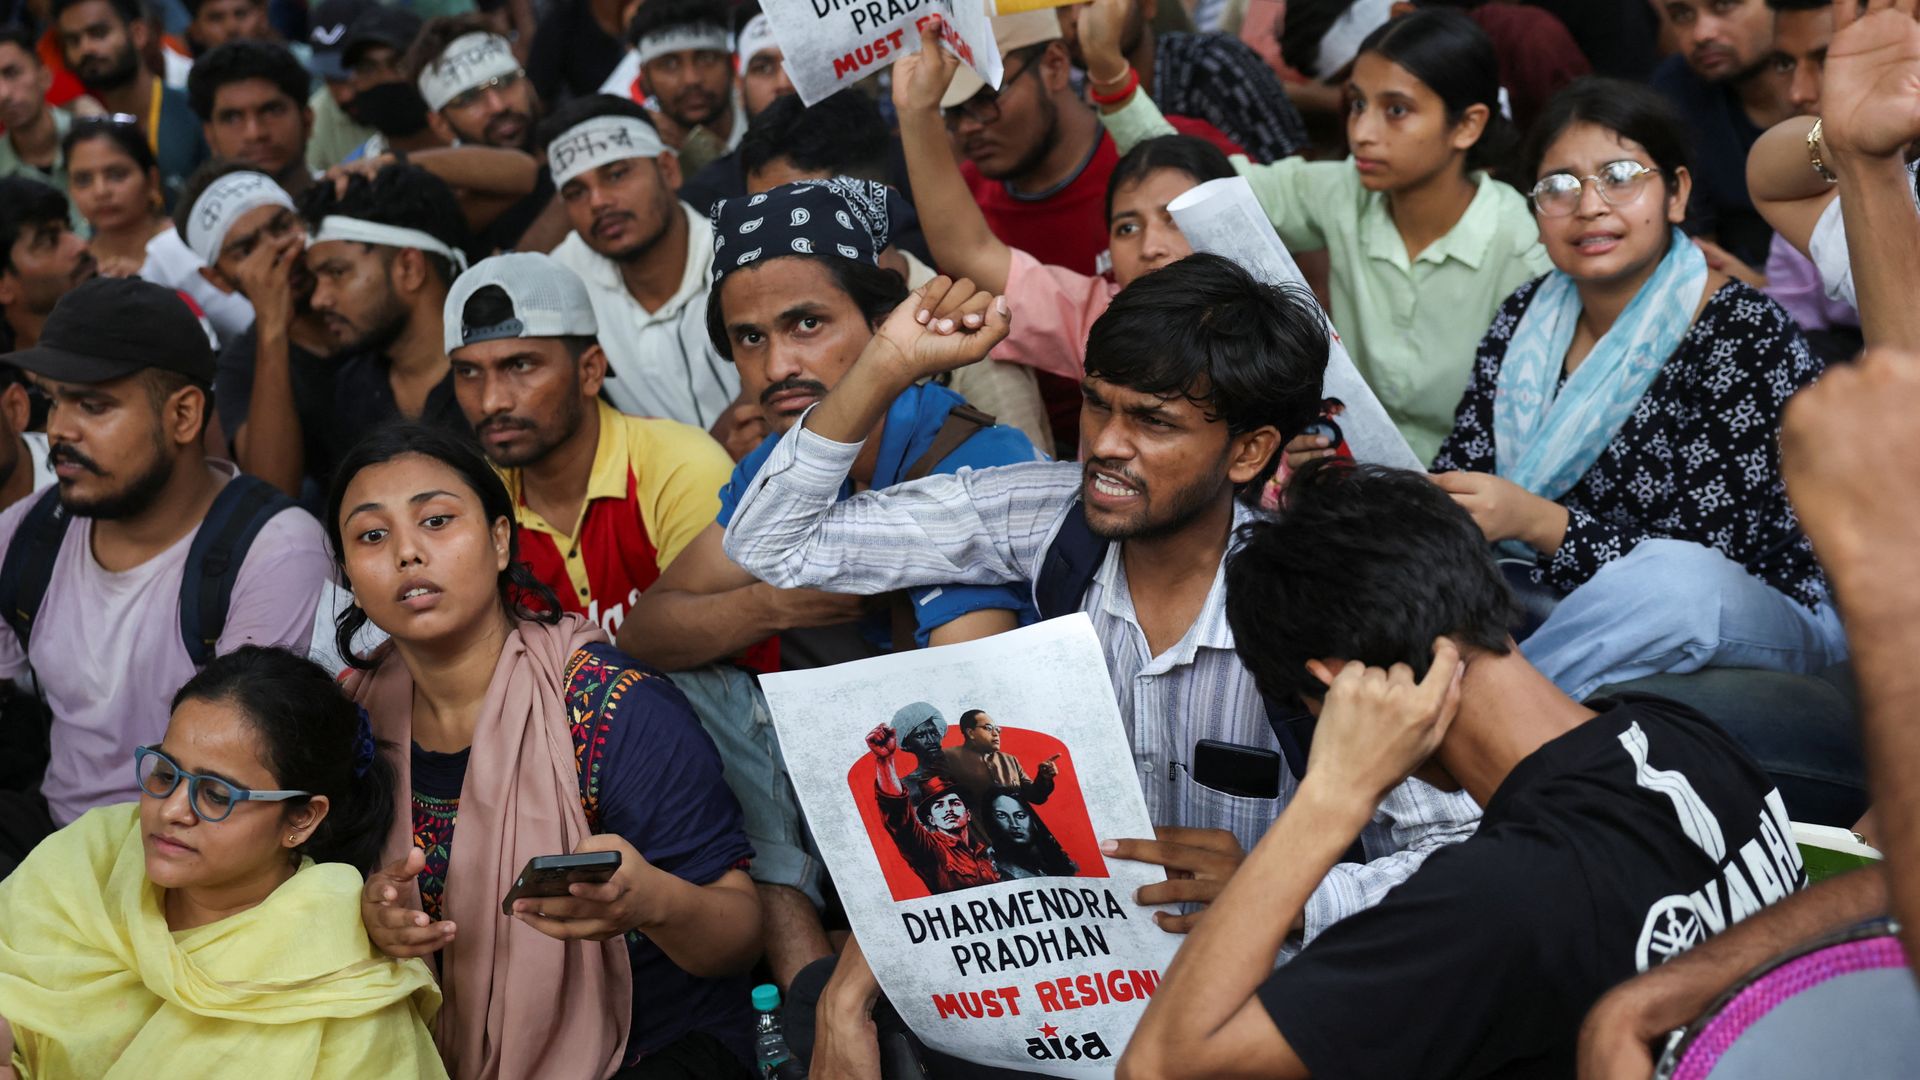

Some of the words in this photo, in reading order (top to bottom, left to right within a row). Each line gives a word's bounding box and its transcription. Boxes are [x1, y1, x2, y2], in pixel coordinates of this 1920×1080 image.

[851, 0, 955, 34] PRAD
[832, 28, 904, 79] MUST
[901, 887, 1128, 944] DHARMENDRA
[951, 924, 1111, 977] PRADHAN
[931, 986, 1021, 1020] MUST
